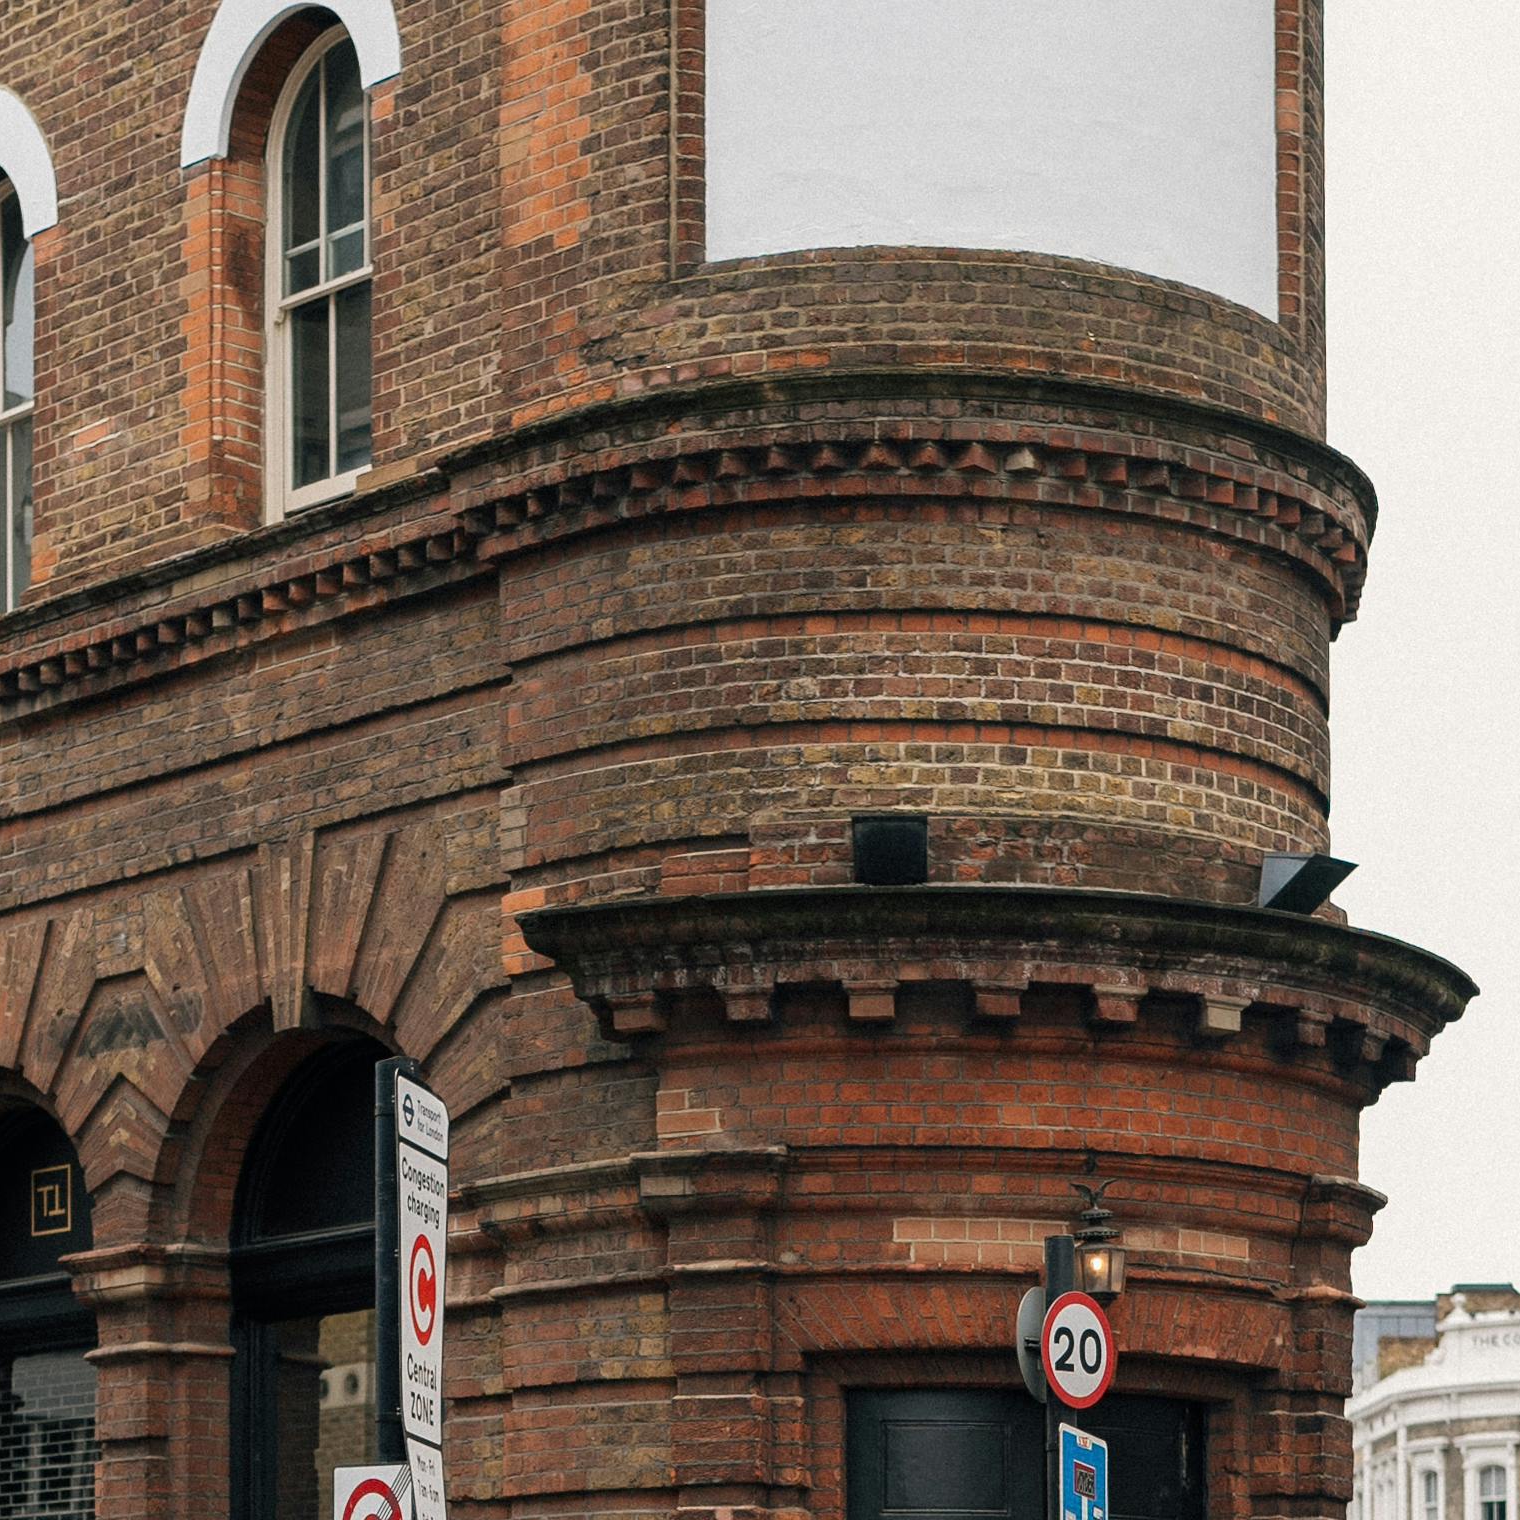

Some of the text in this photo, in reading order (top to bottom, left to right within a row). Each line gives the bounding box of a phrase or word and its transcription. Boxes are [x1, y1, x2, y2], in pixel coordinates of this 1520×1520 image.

[417, 1099, 441, 1125] Transport
[417, 1117, 444, 1143] for London
[401, 1156, 445, 1199] Congestion
[407, 1191, 440, 1229] charging
[1053, 1326, 1102, 1374] 20
[1471, 1335, 1499, 1347] THE
[407, 1352, 437, 1392] Central
[410, 1391, 434, 1427] ZONE
